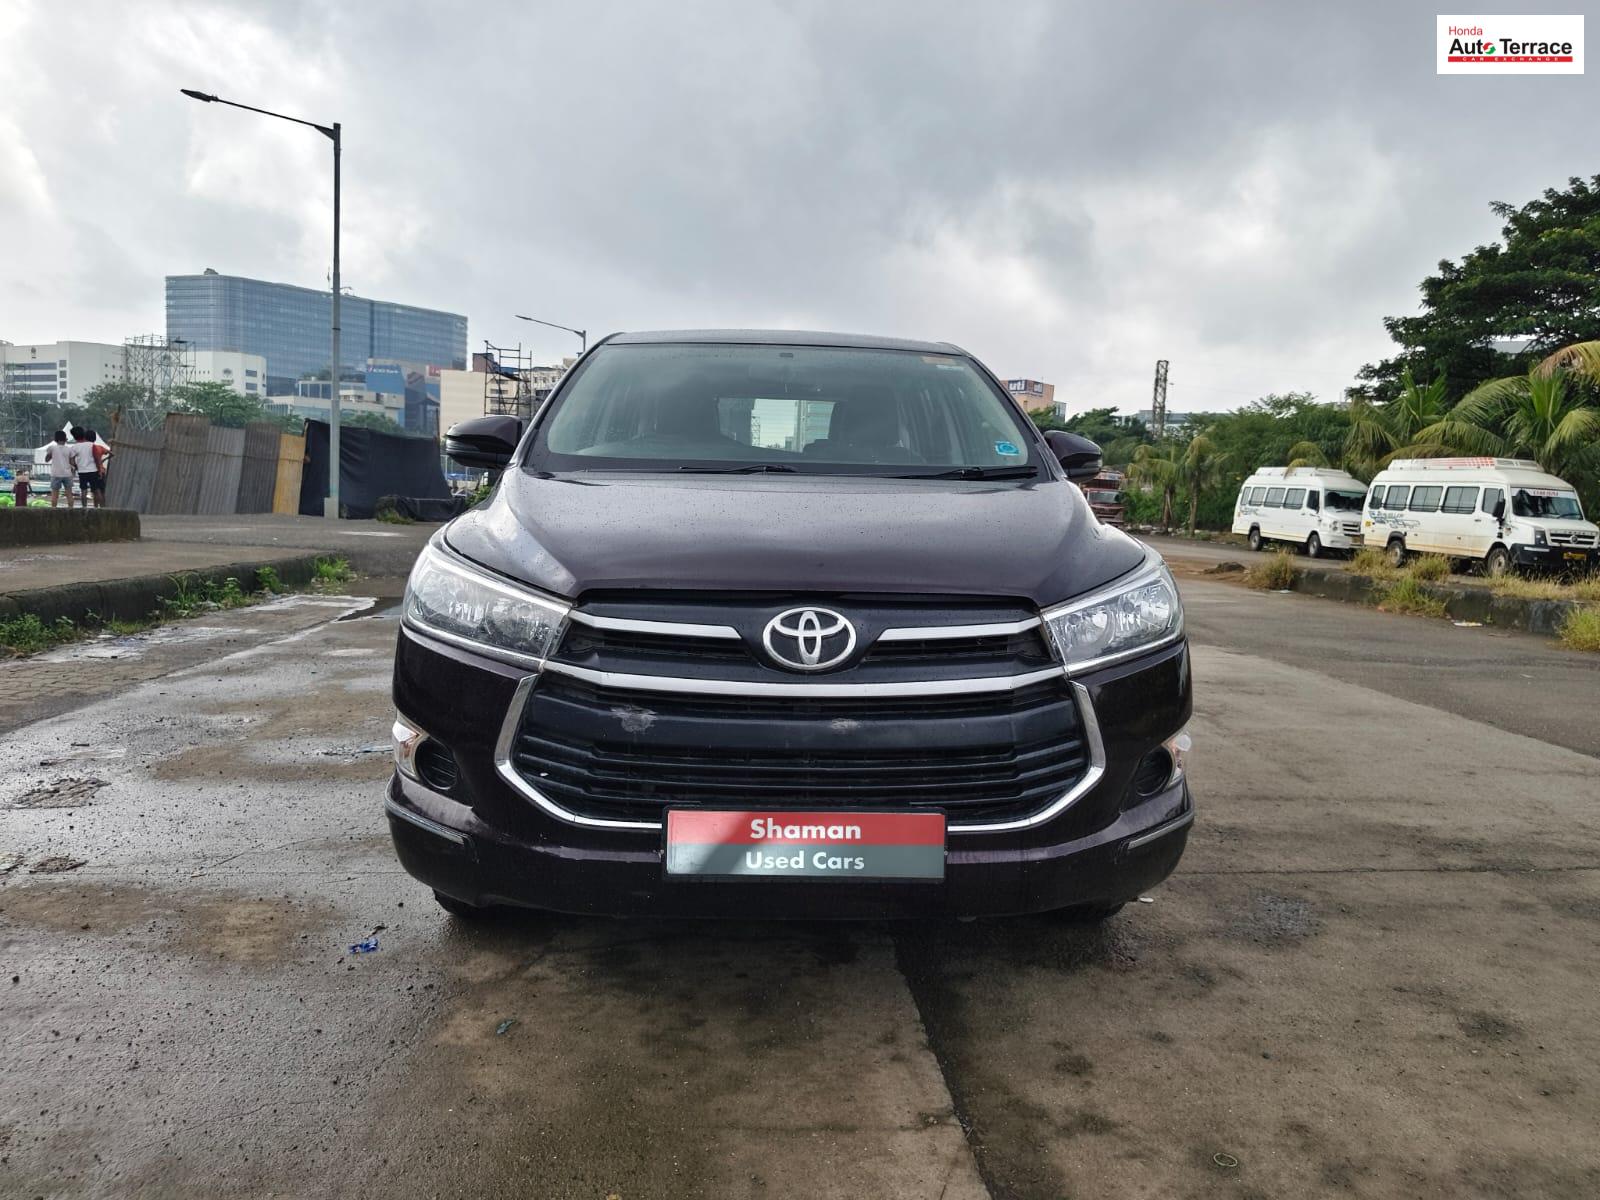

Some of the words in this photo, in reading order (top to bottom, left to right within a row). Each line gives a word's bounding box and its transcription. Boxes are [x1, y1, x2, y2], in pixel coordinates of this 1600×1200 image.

[750, 818, 862, 840] Shaman
[745, 851, 805, 870] Used
[812, 852, 865, 871] Cars
